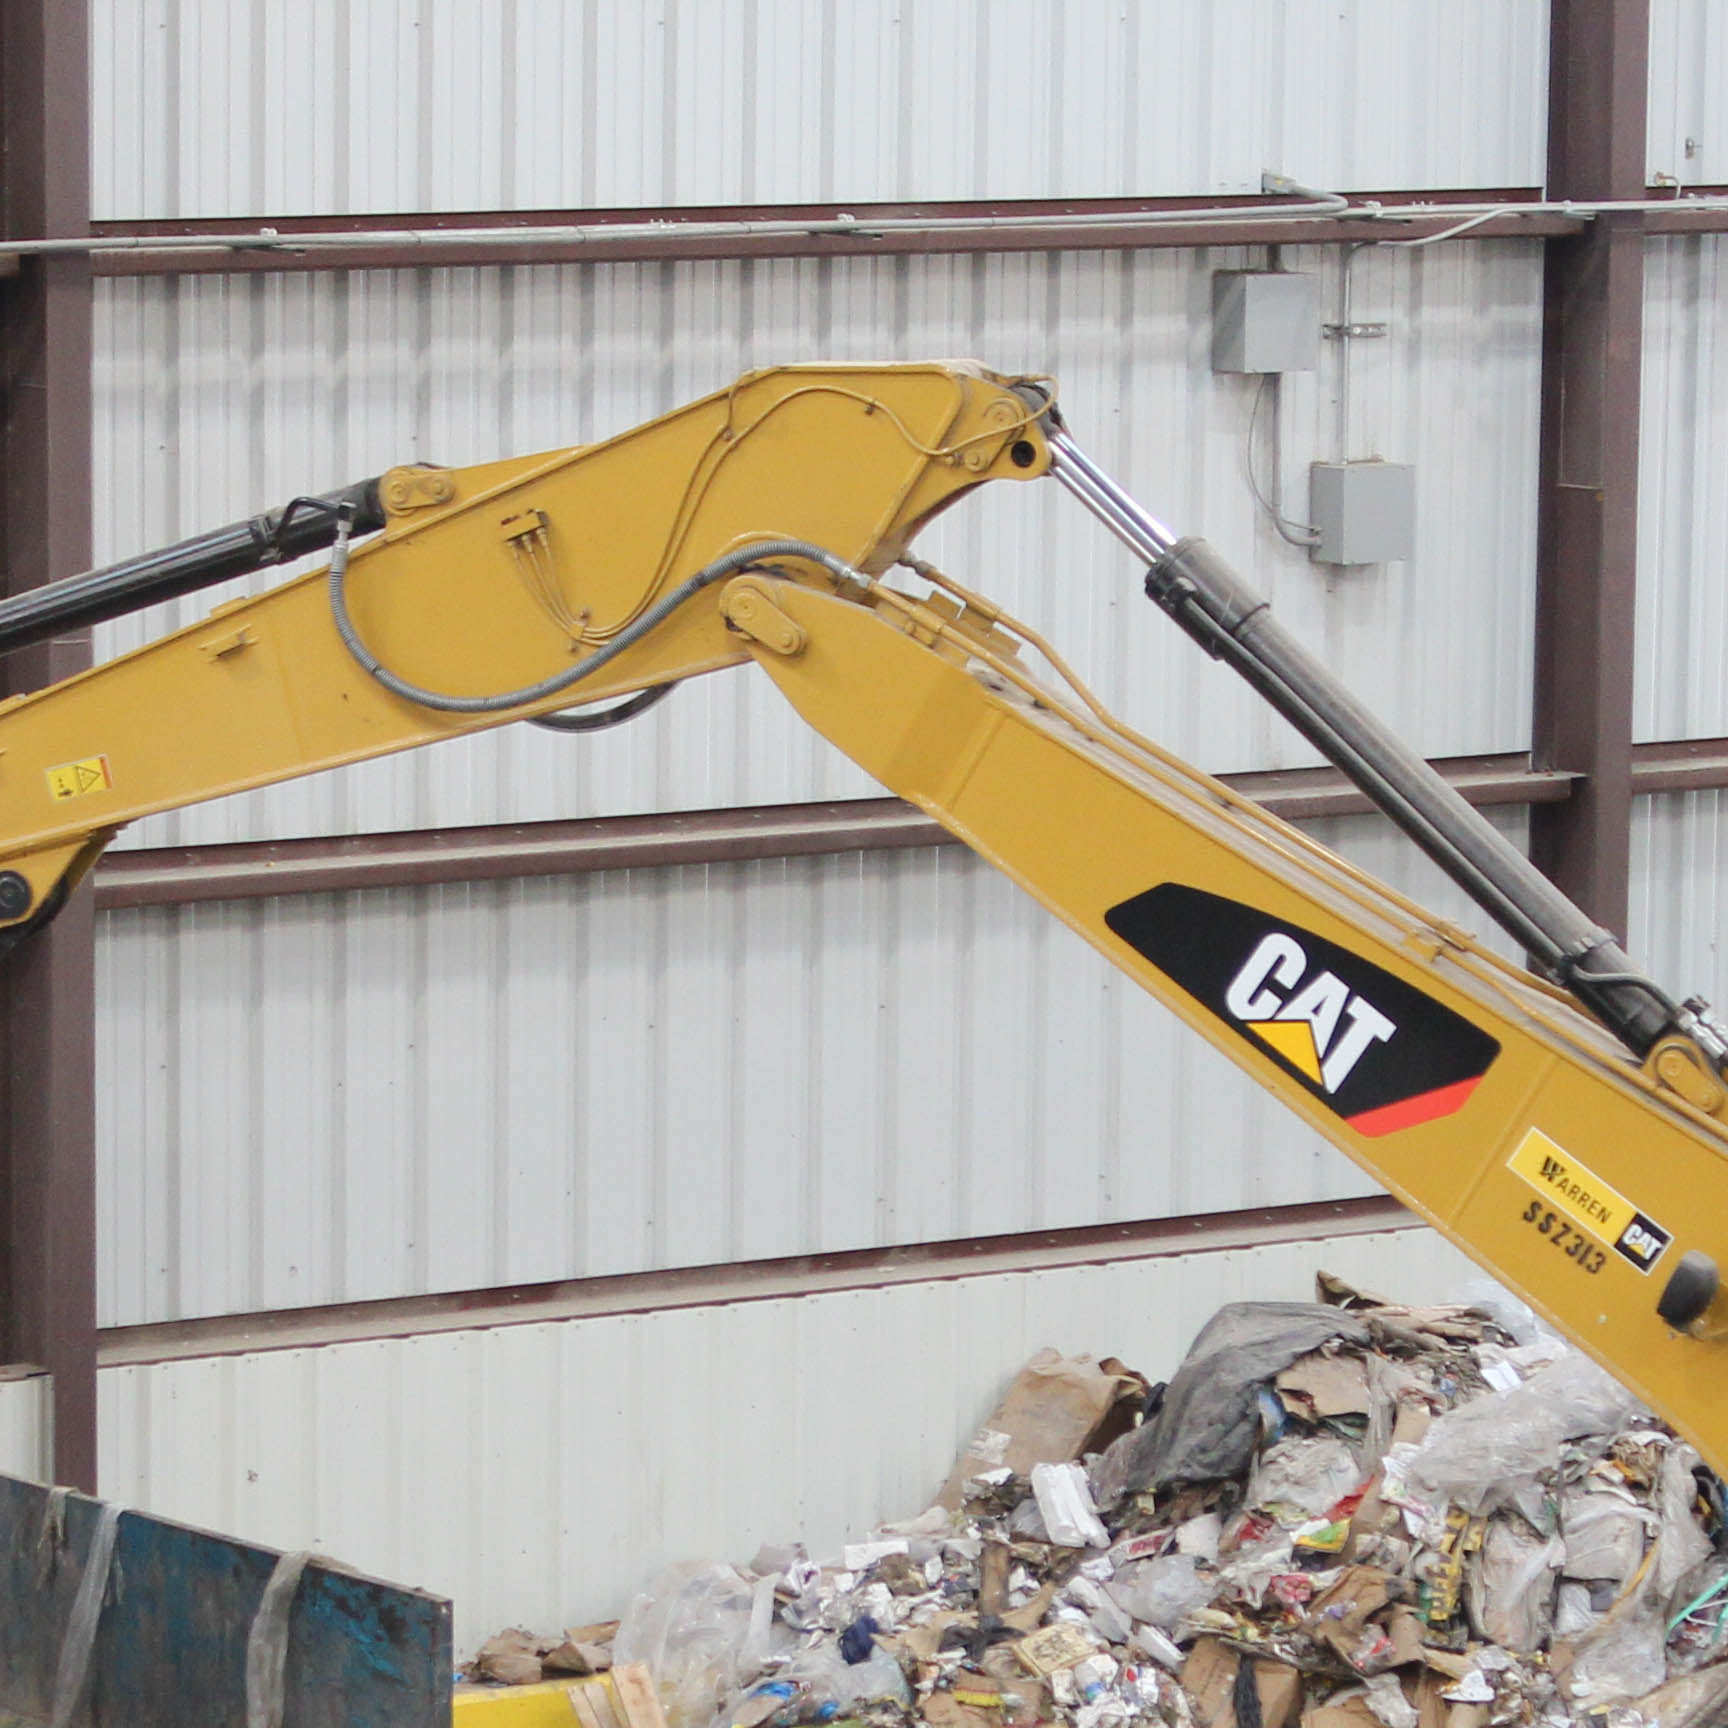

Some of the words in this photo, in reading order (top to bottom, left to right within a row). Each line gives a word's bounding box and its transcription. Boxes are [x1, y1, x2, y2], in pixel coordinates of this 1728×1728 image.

[1226, 932, 1398, 1095] CAT
[1522, 1200, 1607, 1275] SSZ313
[1539, 1155, 1614, 1225] WARREN
[1622, 1222, 1664, 1261] CAT
